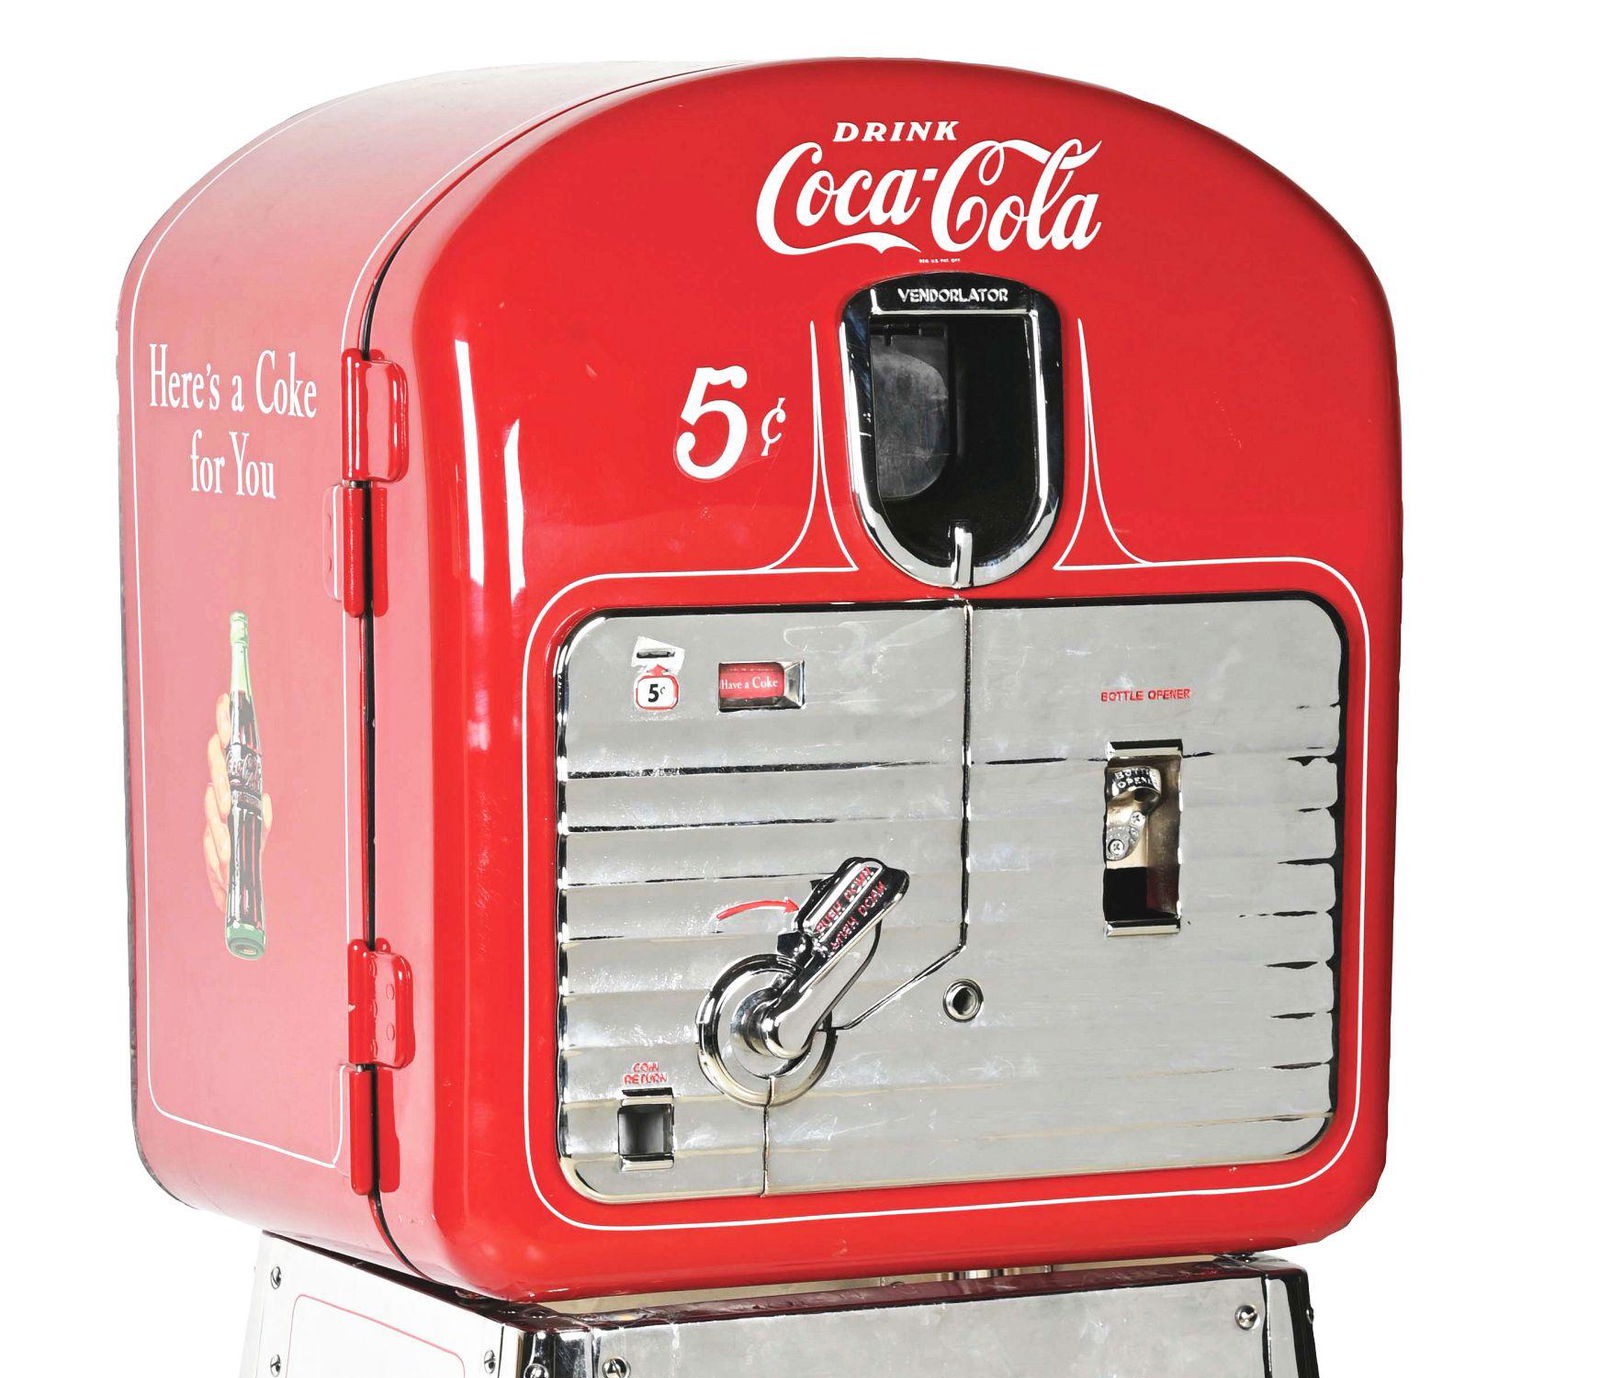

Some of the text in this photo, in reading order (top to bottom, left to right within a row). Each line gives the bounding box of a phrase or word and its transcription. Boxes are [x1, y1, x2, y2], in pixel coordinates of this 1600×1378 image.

[833, 121, 959, 142] DRINK
[756, 138, 1102, 256] Coca-Cola
[897, 287, 1009, 303] VENDORLATOR
[149, 343, 317, 418] Here's a Coke
[190, 429, 276, 499] for You
[719, 678, 742, 690] Have
[752, 675, 779, 689] Coke
[1101, 688, 1191, 702] BOTTLE OPENER
[632, 1062, 659, 1073] COIN
[623, 1072, 667, 1085] RETURN
